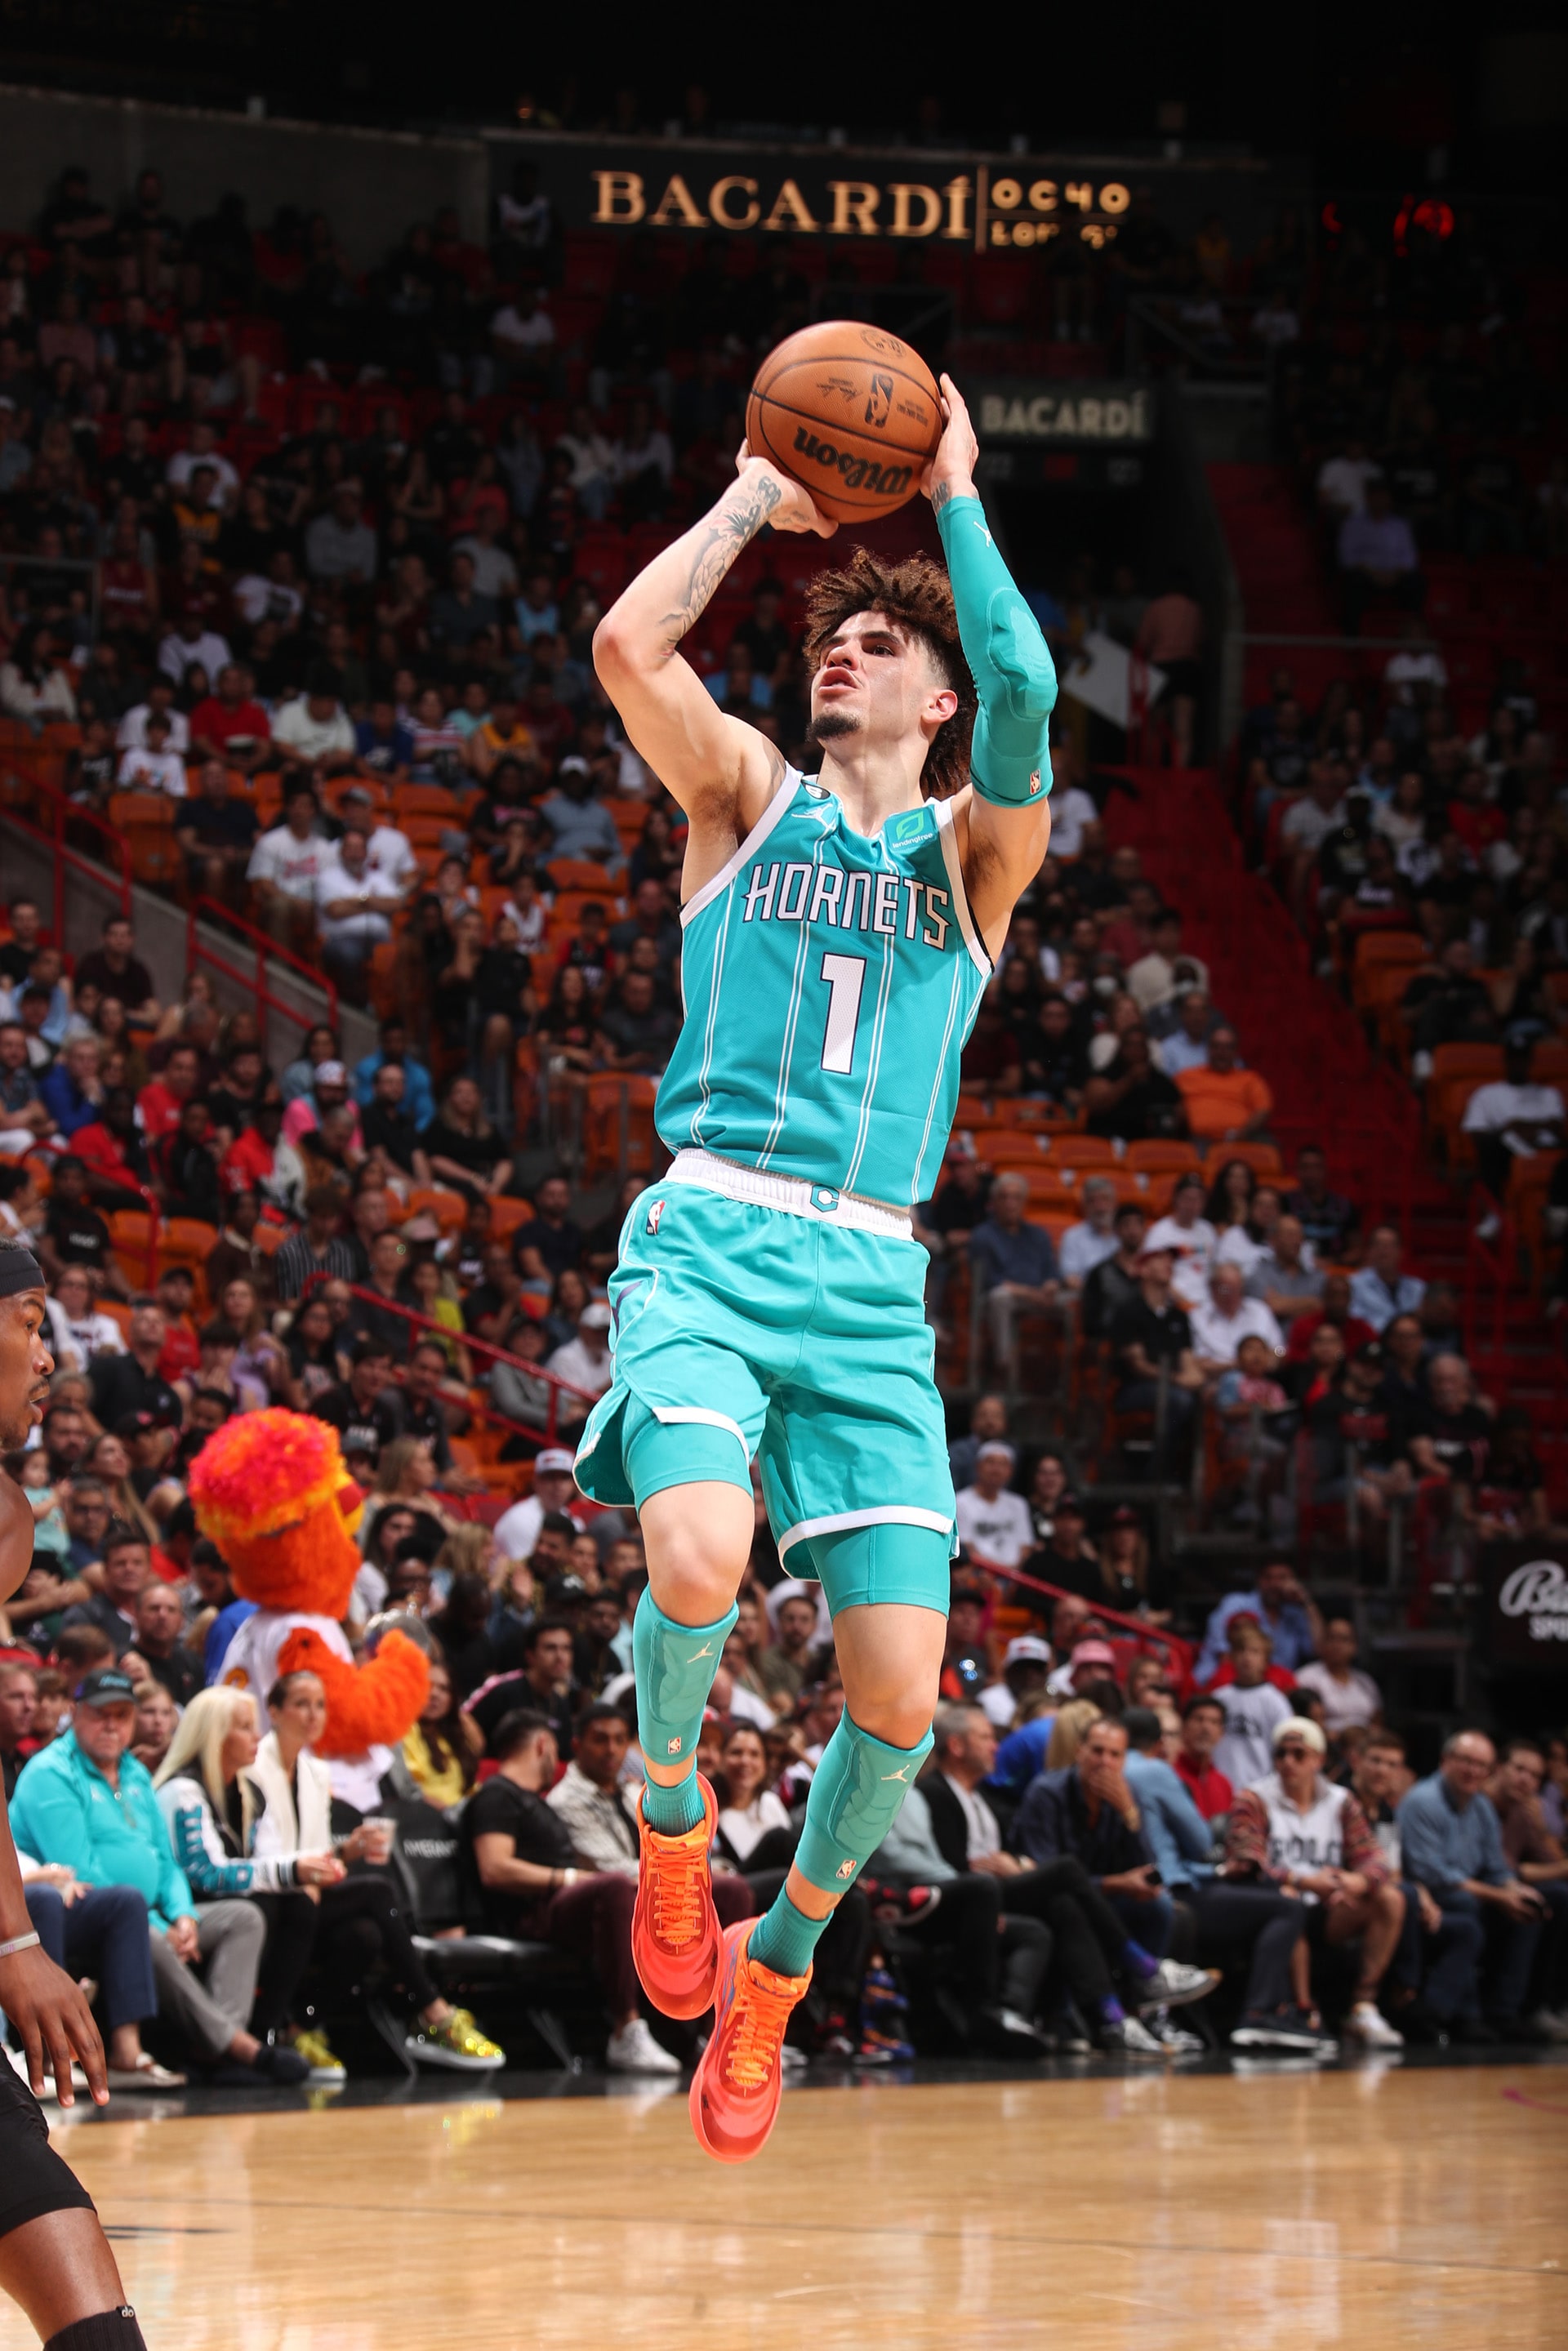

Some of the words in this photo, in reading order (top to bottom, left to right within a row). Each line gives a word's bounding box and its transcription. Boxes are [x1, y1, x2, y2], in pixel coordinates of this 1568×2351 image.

[591, 168, 973, 240] BACARDÍ
[981, 390, 1147, 439] BACARDÍ
[793, 426, 913, 495] Wilson
[892, 832, 933, 848] lendingtree
[742, 862, 953, 951] HORNETS
[820, 951, 867, 1075] 1
